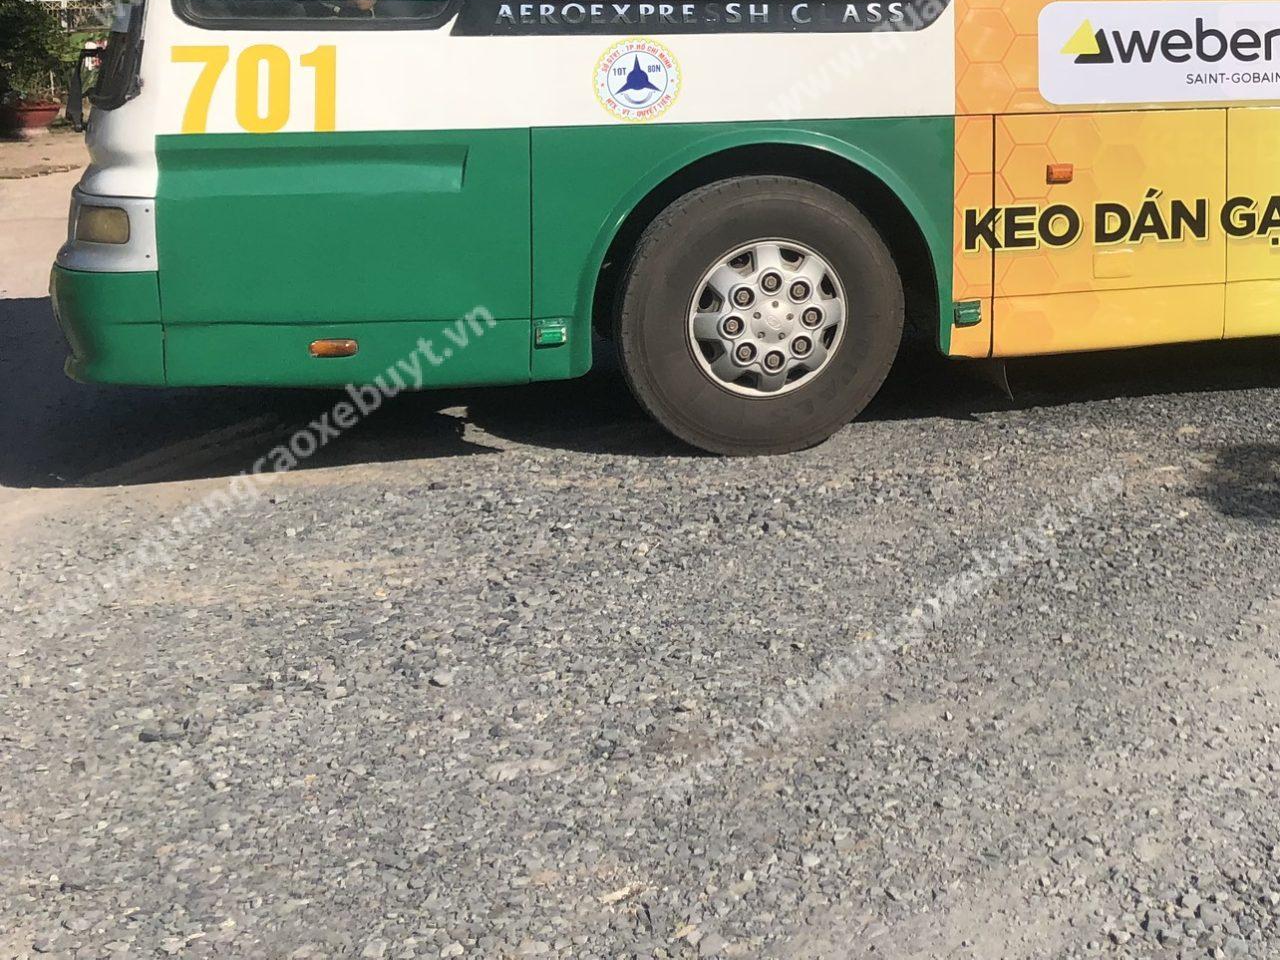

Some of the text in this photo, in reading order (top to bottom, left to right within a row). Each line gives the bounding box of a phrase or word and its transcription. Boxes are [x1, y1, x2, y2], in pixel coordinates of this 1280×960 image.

[170, 44, 337, 134] 701
[964, 205, 1081, 251] KEO
[1094, 188, 1209, 244] DÁN
